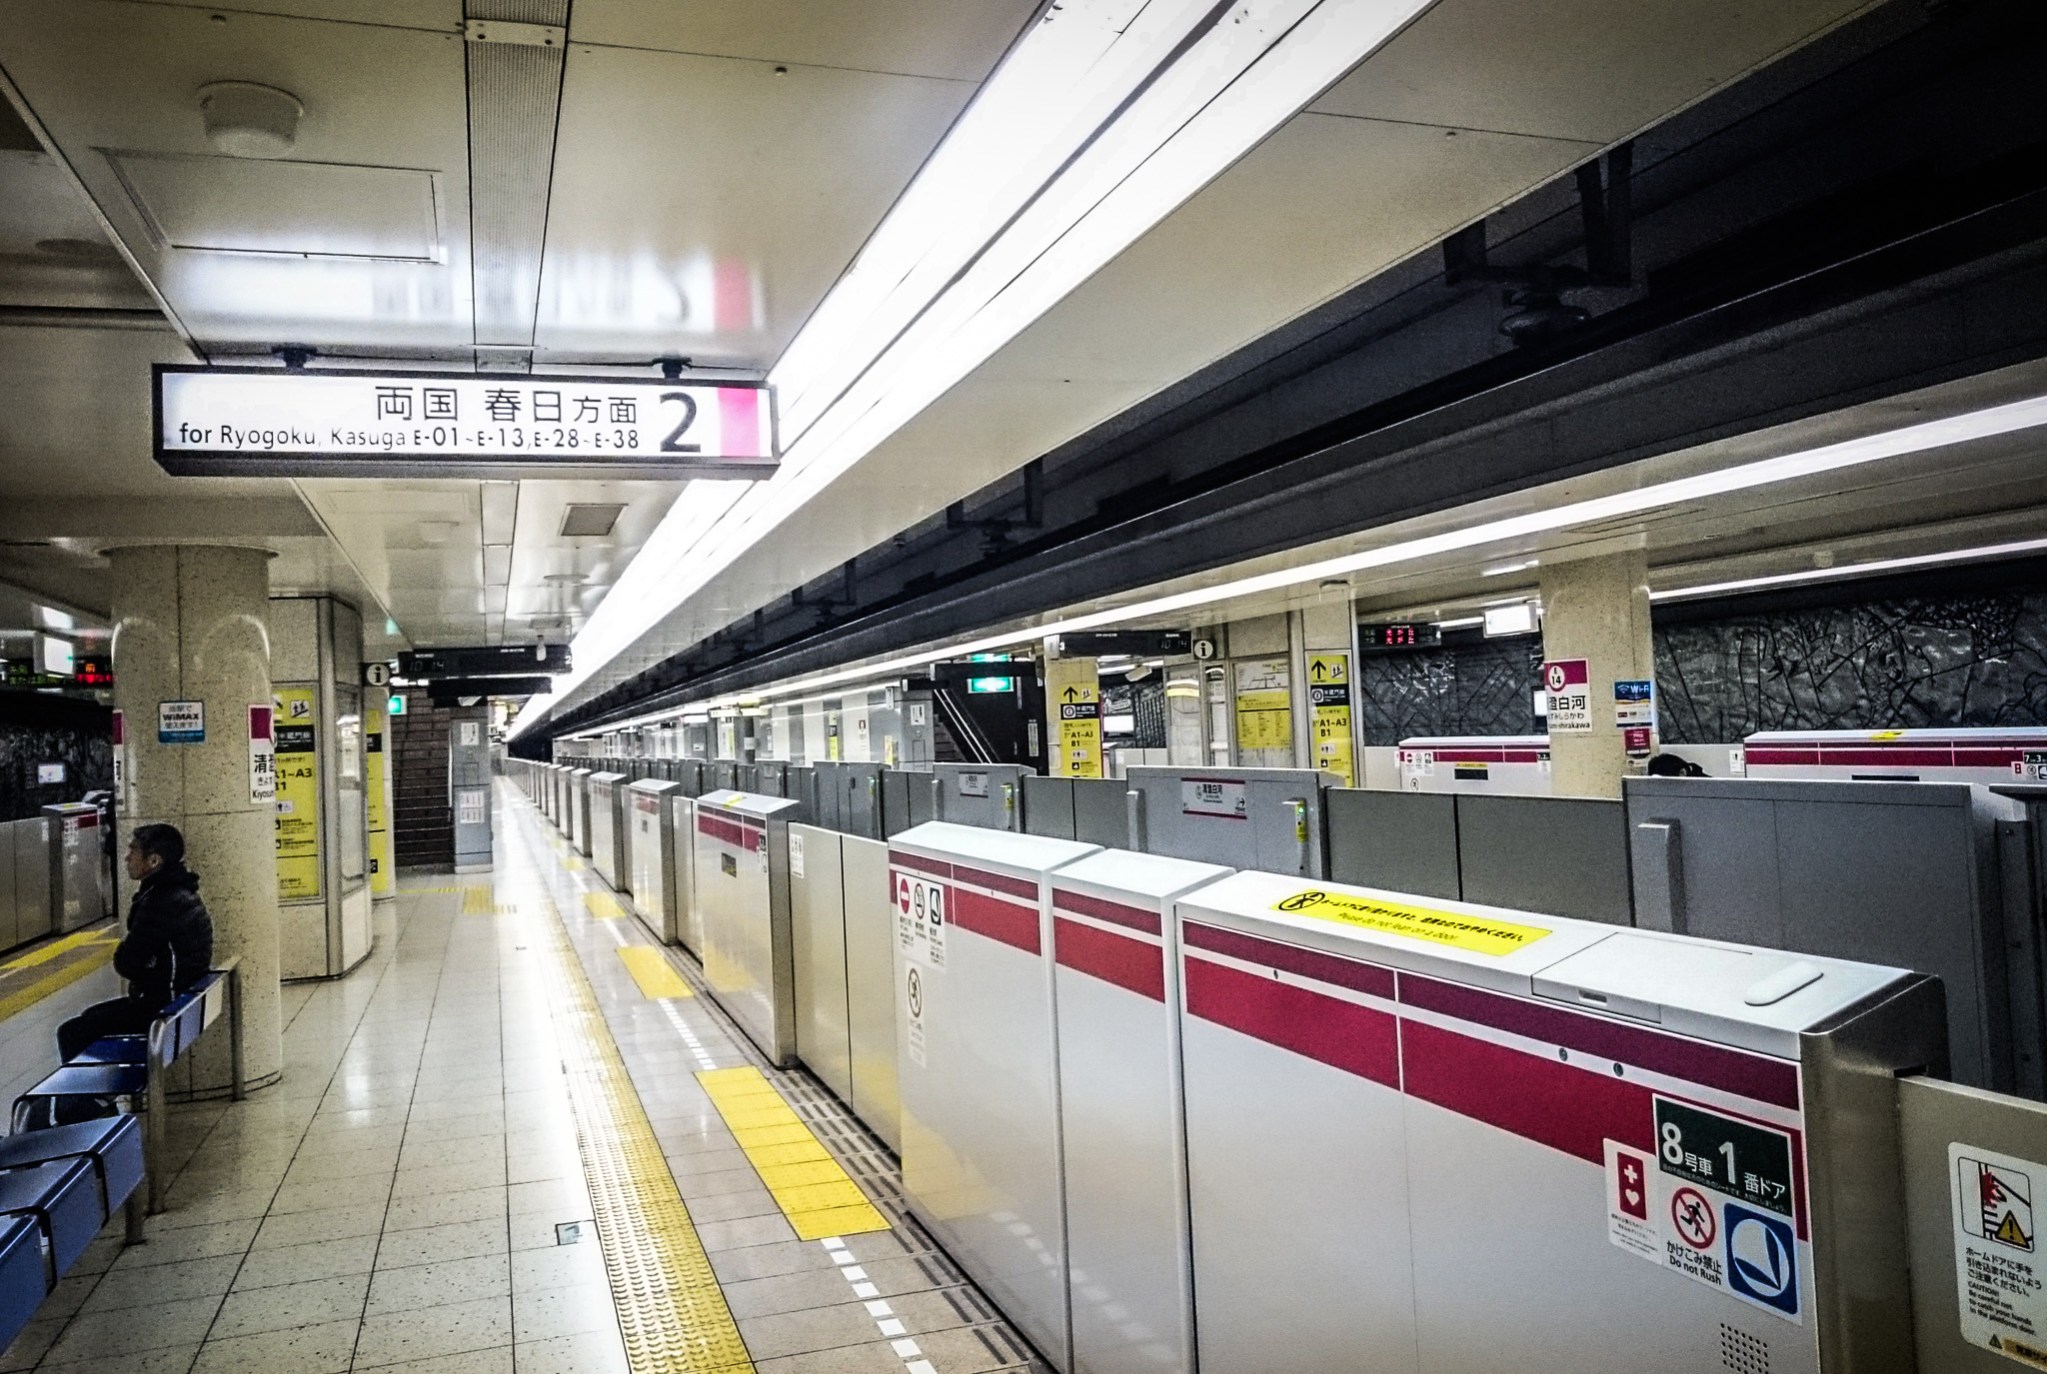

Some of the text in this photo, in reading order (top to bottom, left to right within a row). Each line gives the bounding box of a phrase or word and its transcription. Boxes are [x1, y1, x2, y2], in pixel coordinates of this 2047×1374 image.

[375, 386, 637, 424] 両国 春日方面
[180, 423, 212, 444] for
[331, 427, 406, 451] Kasuga
[659, 392, 701, 453] 2
[1551, 676, 1561, 685] 14
[163, 713, 199, 721] WiMAX
[1661, 1121, 1786, 1199] 8号車 1番ドア
[1666, 1240, 1723, 1275] かけこみ禁止
[1669, 1254, 1722, 1286] Do not Rush
[1966, 1246, 2033, 1276] ホームドアに手を
